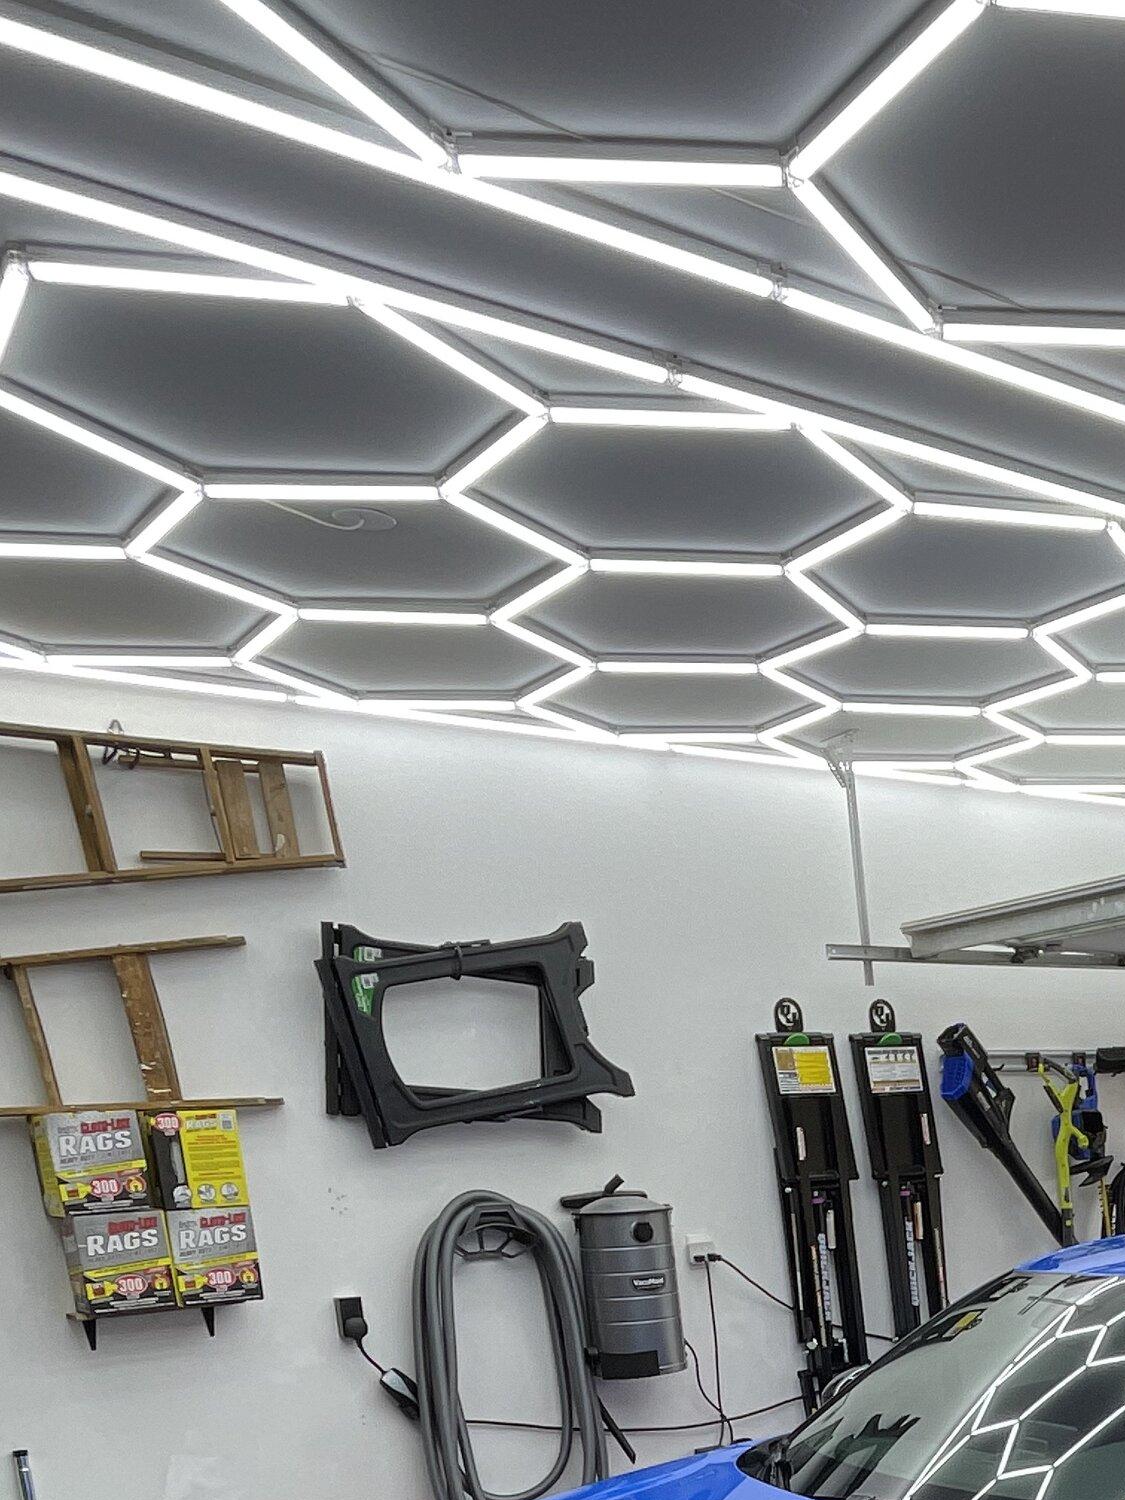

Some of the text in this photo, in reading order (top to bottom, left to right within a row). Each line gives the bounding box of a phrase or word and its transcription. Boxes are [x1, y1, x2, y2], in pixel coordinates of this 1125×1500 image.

[157, 1117, 179, 1130] 300
[59, 1131, 131, 1156] RAGS
[92, 1180, 118, 1194] 300
[86, 1229, 158, 1256] RAGS
[179, 1224, 246, 1249] RAGS
[118, 1277, 144, 1292] 300
[208, 1270, 232, 1285] 300
